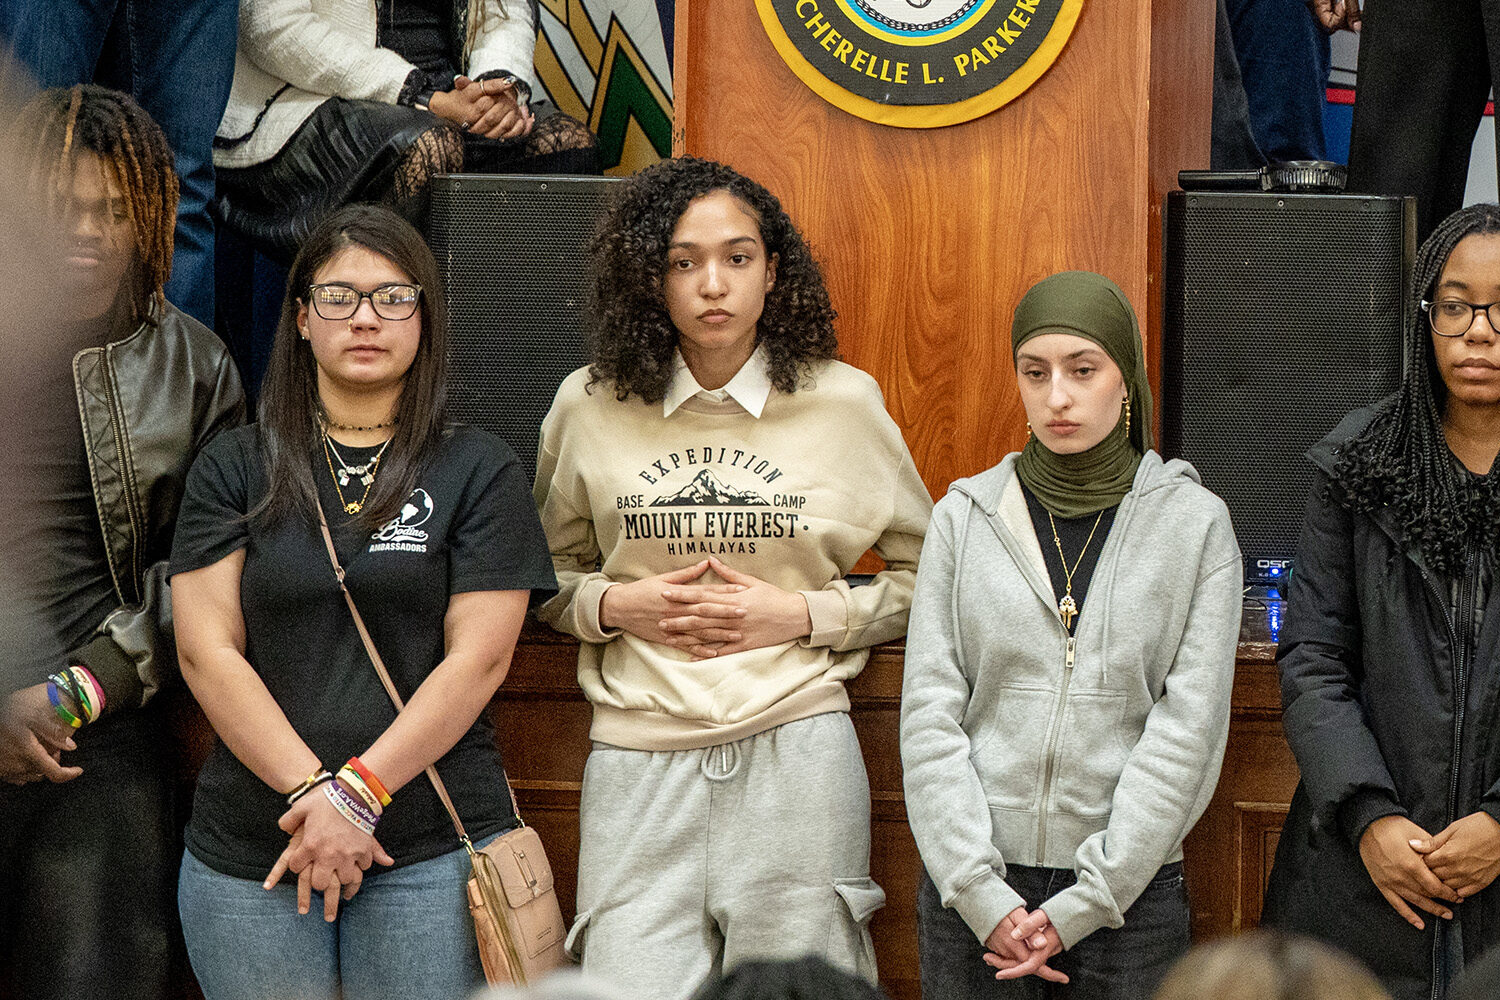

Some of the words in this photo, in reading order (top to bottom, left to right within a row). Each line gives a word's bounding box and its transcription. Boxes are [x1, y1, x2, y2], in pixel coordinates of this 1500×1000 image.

[923, 62, 945, 85] L.
[638, 447, 784, 486] EXPEDITION
[616, 494, 645, 510] BASE
[773, 493, 807, 510] CAMP
[371, 516, 428, 542] Bodine
[623, 512, 697, 540] MOUNT
[704, 511, 799, 539] EVEREST
[368, 542, 427, 553] AMBASSADORS
[666, 541, 757, 556] HIMALAYAS
